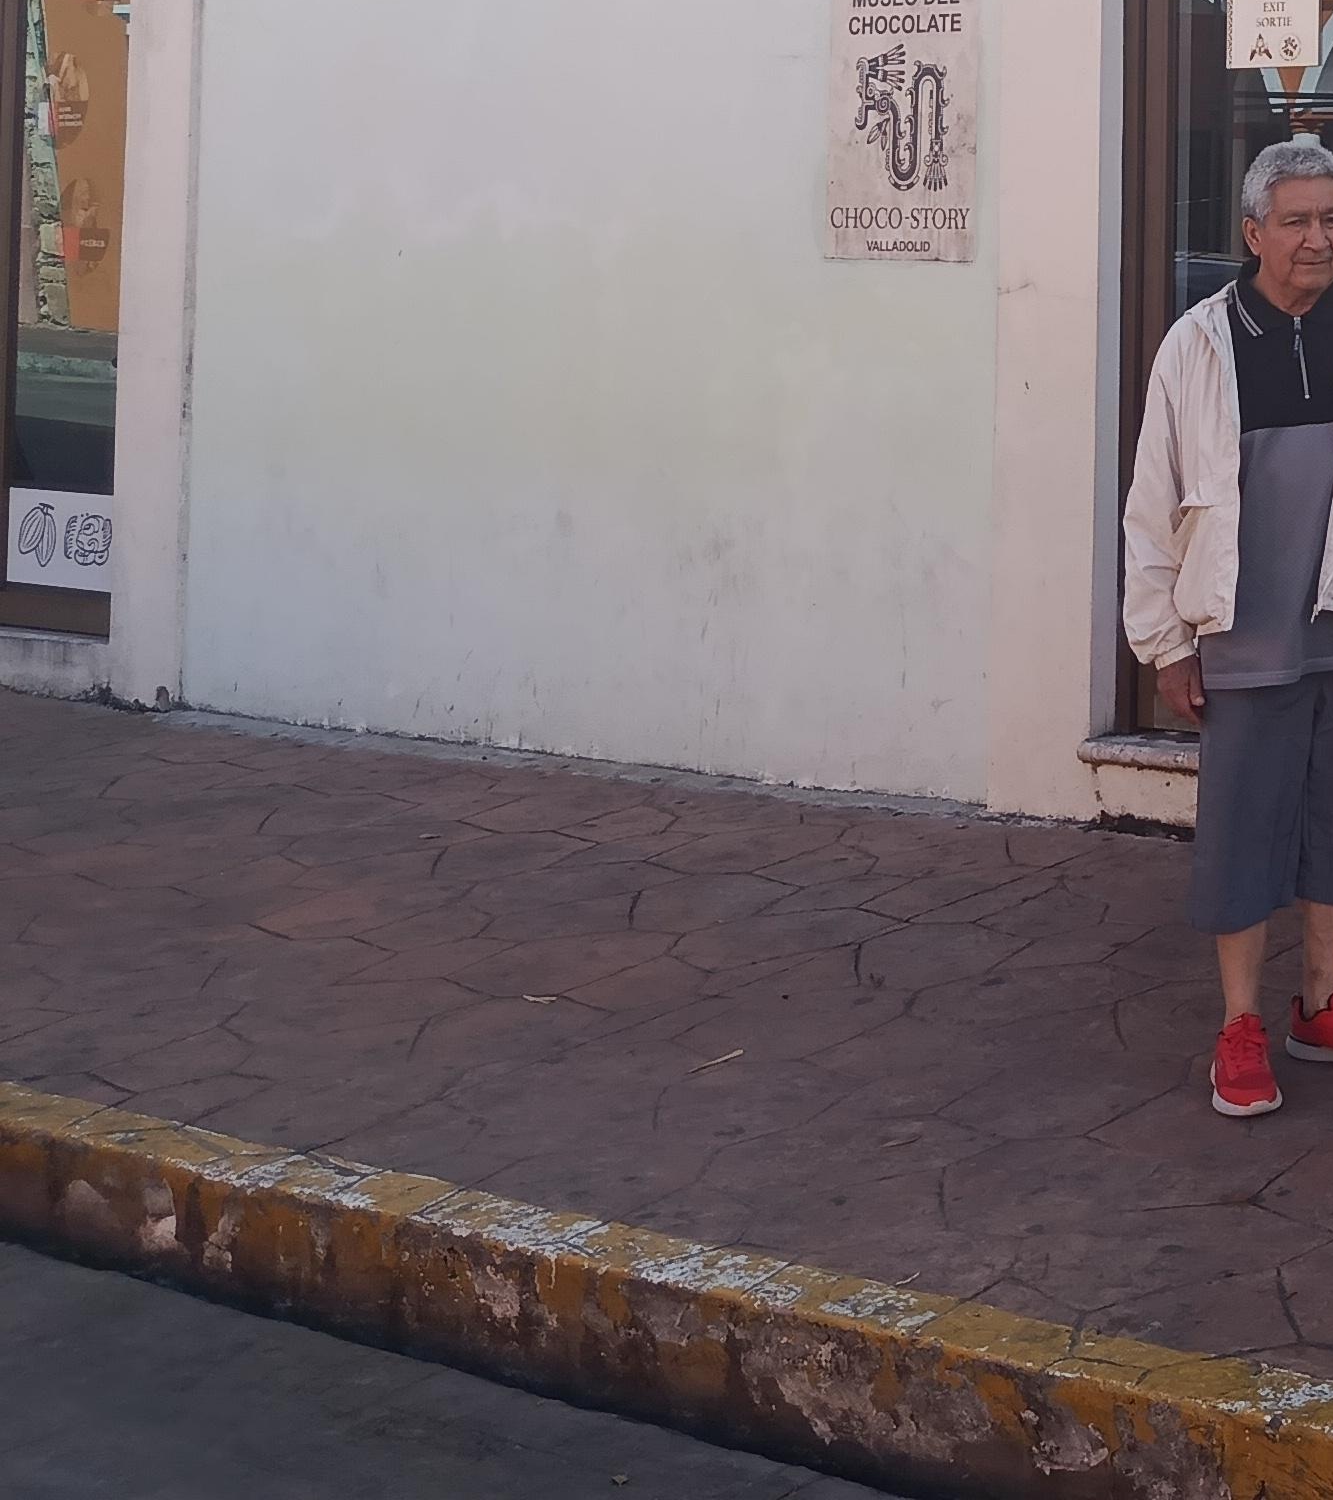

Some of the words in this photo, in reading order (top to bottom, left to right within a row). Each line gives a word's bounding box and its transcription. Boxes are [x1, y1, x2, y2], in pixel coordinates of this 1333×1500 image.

[1263, 1, 1286, 13] EXIT
[848, 13, 962, 35] CHOCOLATE
[1256, 16, 1293, 28] SORTIE
[830, 206, 970, 230] CHOCO-STORY
[866, 240, 931, 252] VALLADOLID
